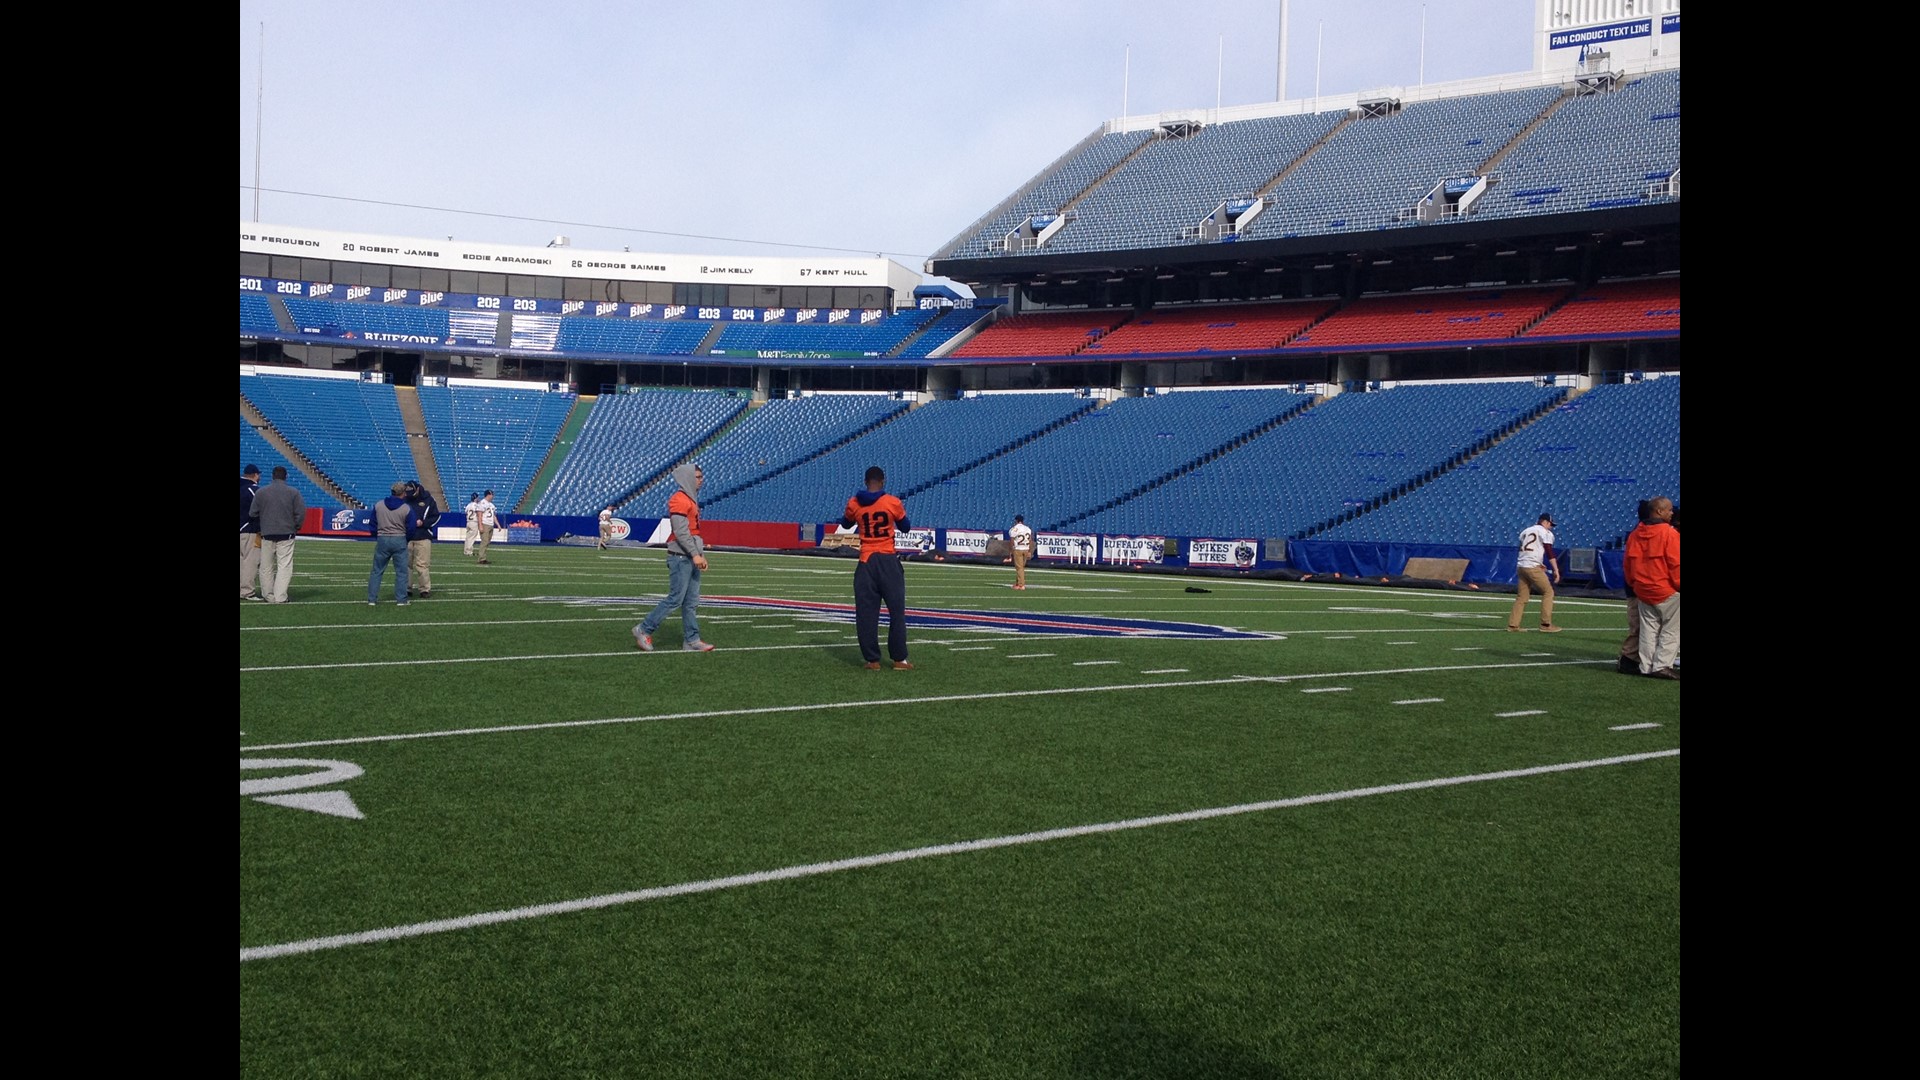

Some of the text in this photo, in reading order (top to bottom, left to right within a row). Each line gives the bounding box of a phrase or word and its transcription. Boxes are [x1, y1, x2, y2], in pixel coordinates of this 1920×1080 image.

[1552, 23, 1649, 45] FAN CONDUCT TEXT LINE
[261, 236, 320, 247] FERGUSON
[343, 243, 440, 257] 20 ROBERT JAMES
[571, 260, 583, 268] 26
[240, 278, 262, 291] 201
[277, 281, 301, 295] 202
[310, 283, 333, 297] Blue
[347, 286, 371, 300] Blue
[383, 289, 407, 303] Blue
[420, 292, 443, 305] Blue
[477, 297, 500, 309] 202
[513, 299, 537, 311] 203
[562, 300, 585, 315] Blue
[595, 302, 618, 317] Blue
[920, 299, 940, 310] 204
[953, 299, 974, 309] 205
[630, 303, 652, 318] Blue
[664, 305, 686, 320] Blue
[698, 308, 721, 319] 203
[732, 309, 755, 320] 204
[763, 308, 785, 323] Blue
[796, 308, 818, 324] Blue
[828, 308, 850, 324] Blue
[860, 309, 882, 324] Blue
[862, 511, 889, 538] 12
[1037, 537, 1080, 546] SEARCY'S
[1049, 546, 1067, 554] WEB
[1198, 552, 1227, 562] TYKES
